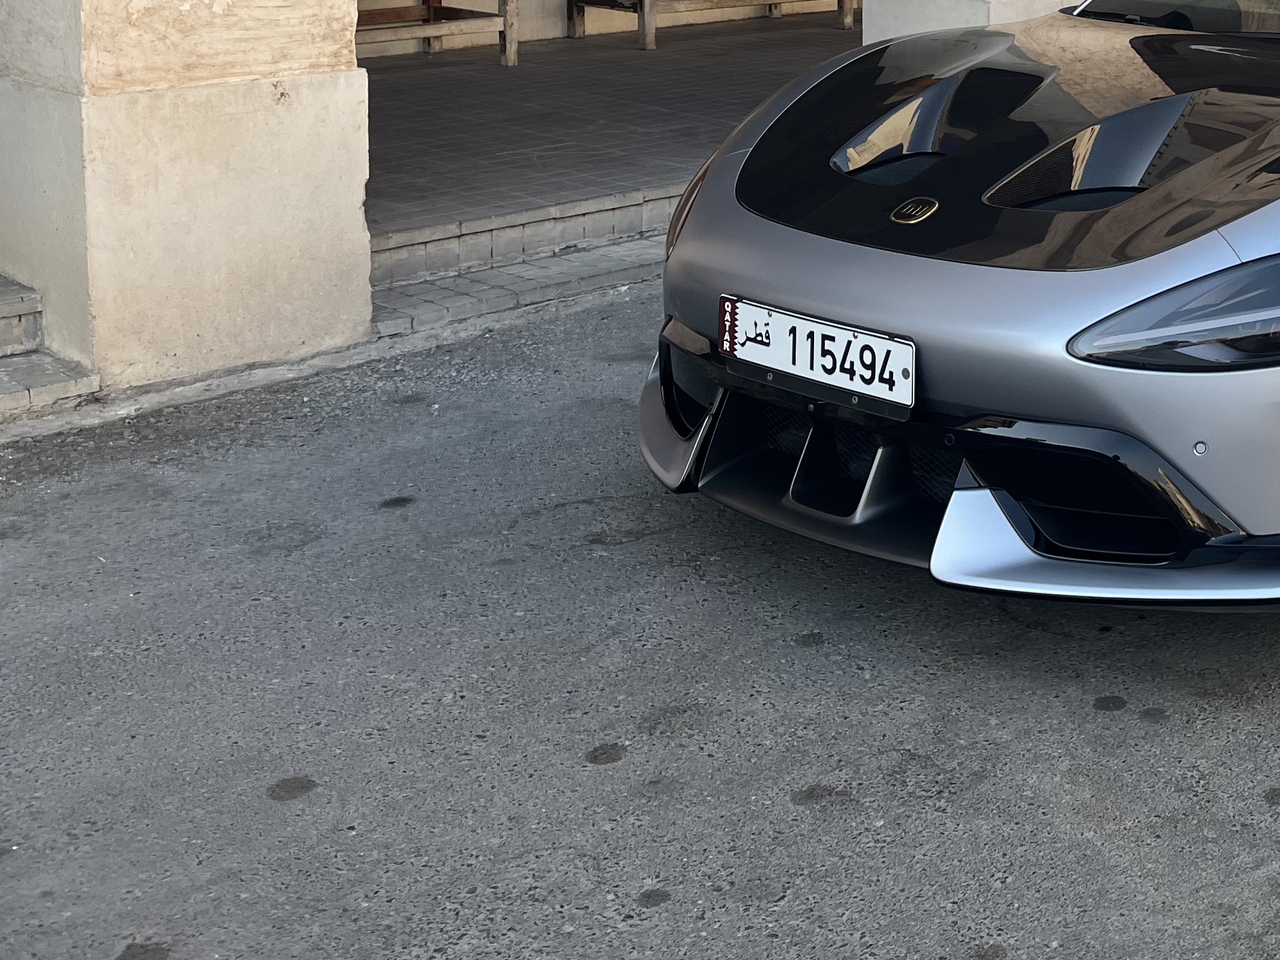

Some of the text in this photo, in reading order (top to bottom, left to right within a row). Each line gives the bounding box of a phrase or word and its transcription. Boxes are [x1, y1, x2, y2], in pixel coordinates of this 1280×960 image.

[723, 301, 732, 351] QATAR
[737, 320, 771, 348] قطر
[788, 325, 896, 392] 115494
